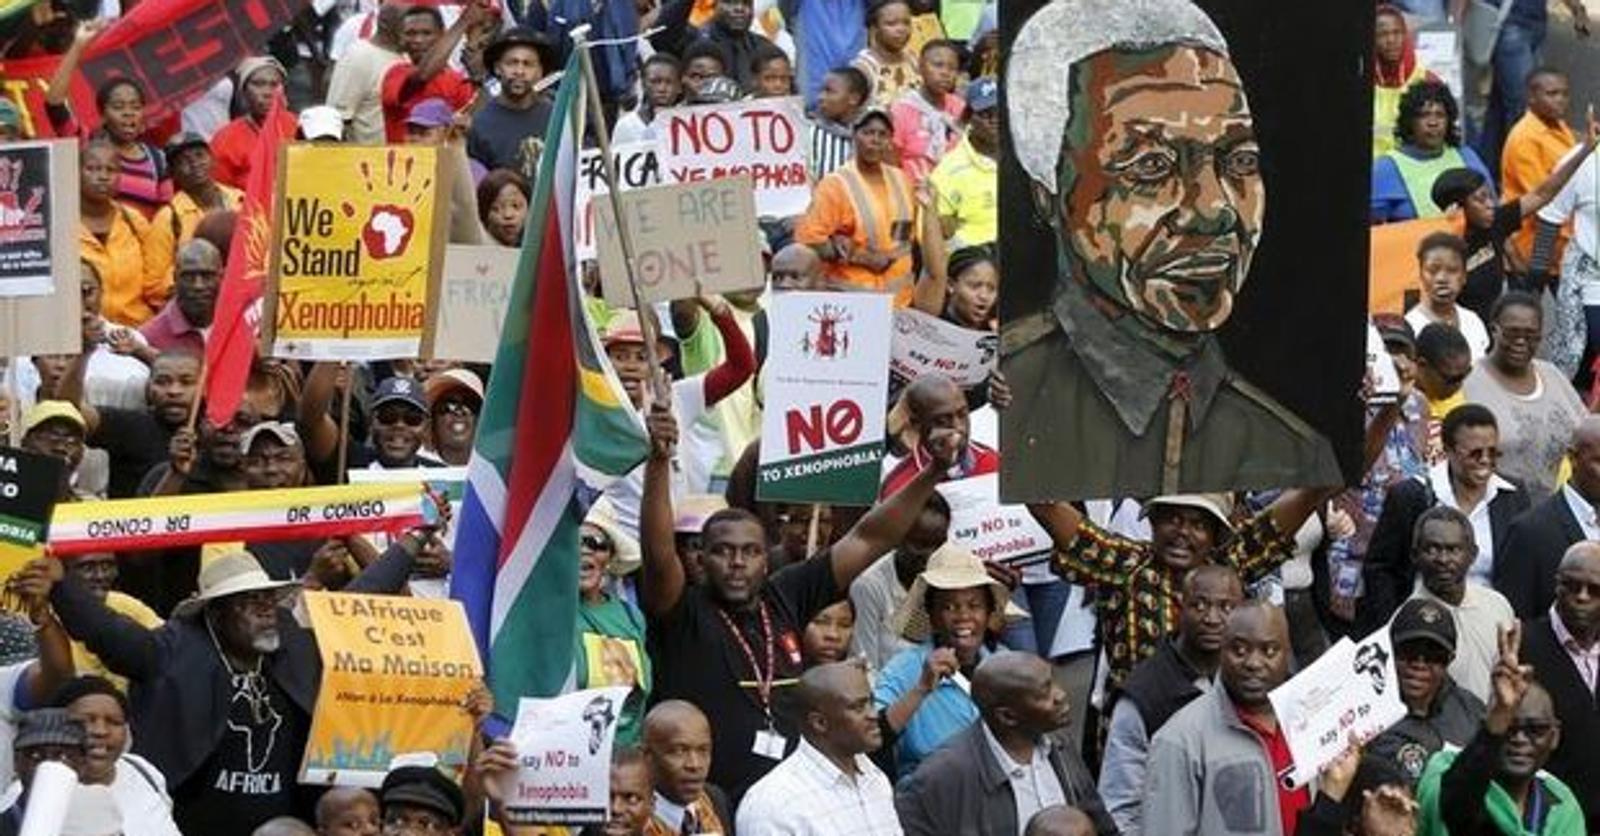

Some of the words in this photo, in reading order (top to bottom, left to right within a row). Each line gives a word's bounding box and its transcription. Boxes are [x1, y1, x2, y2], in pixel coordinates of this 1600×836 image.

[670, 112, 734, 155] NO
[740, 110, 794, 153] TO
[286, 197, 334, 237] We
[678, 187, 738, 226] ARE
[283, 237, 361, 278] Stand
[638, 239, 722, 288] ONE
[277, 290, 425, 339] Xenophobia
[934, 358, 957, 371] NO
[786, 399, 864, 456] NO
[761, 467, 781, 483] TO
[165, 514, 190, 532] DR
[287, 504, 311, 523] DR
[322, 500, 385, 521] CONGO
[87, 516, 152, 538] CONGO
[955, 527, 978, 539] say
[981, 518, 1004, 533] NO
[1008, 518, 1021, 527] to
[972, 534, 1035, 558] ophobia
[329, 597, 443, 626] L'Afrique
[333, 651, 373, 673] Ma
[383, 653, 474, 679] Maison
[1319, 729, 1338, 746] say
[1339, 708, 1356, 729] NO
[1357, 703, 1371, 717] to
[522, 754, 541, 770] say
[544, 750, 566, 767] NO
[568, 753, 580, 767] to
